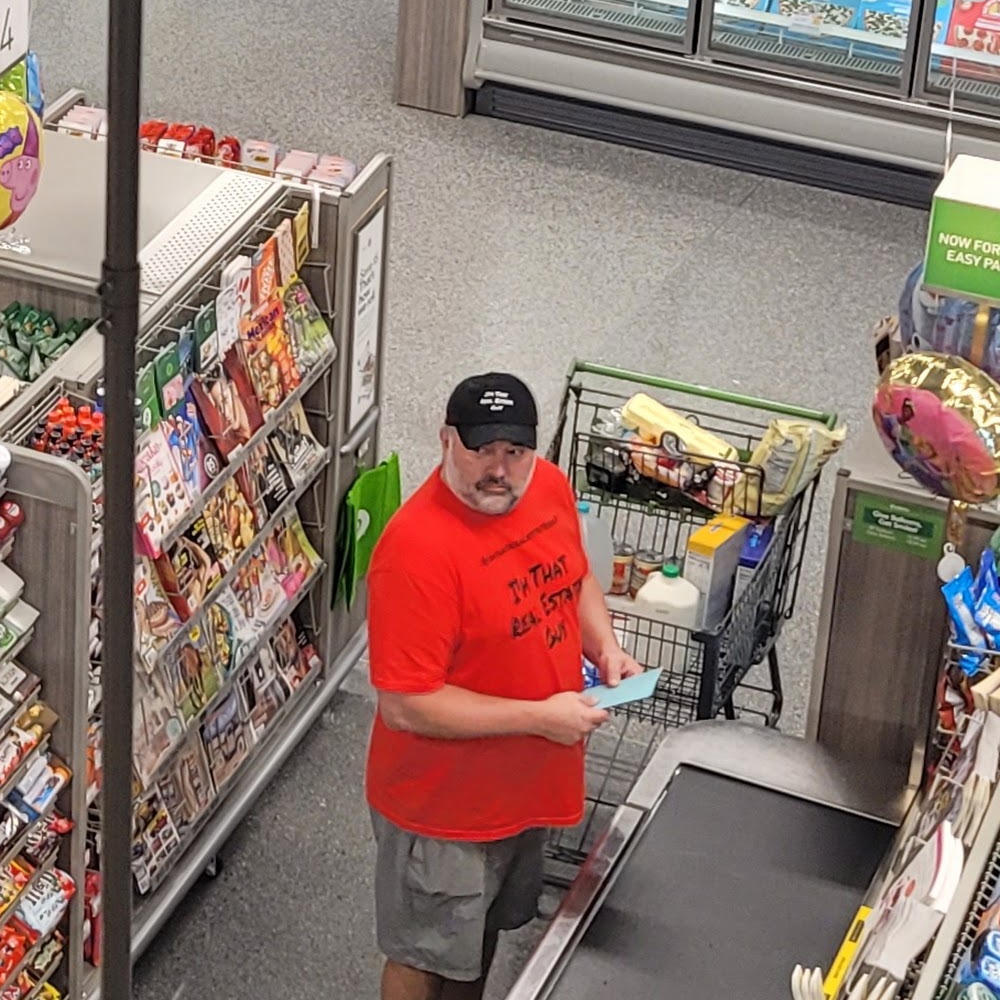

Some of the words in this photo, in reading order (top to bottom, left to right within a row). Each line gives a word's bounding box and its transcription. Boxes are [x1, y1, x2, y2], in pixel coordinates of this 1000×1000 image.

[0, 7, 14, 52] 4
[938, 232, 971, 249] NOW
[946, 250, 982, 267] EASY
[529, 554, 569, 588] THAT
[540, 577, 583, 616] ESTAT
